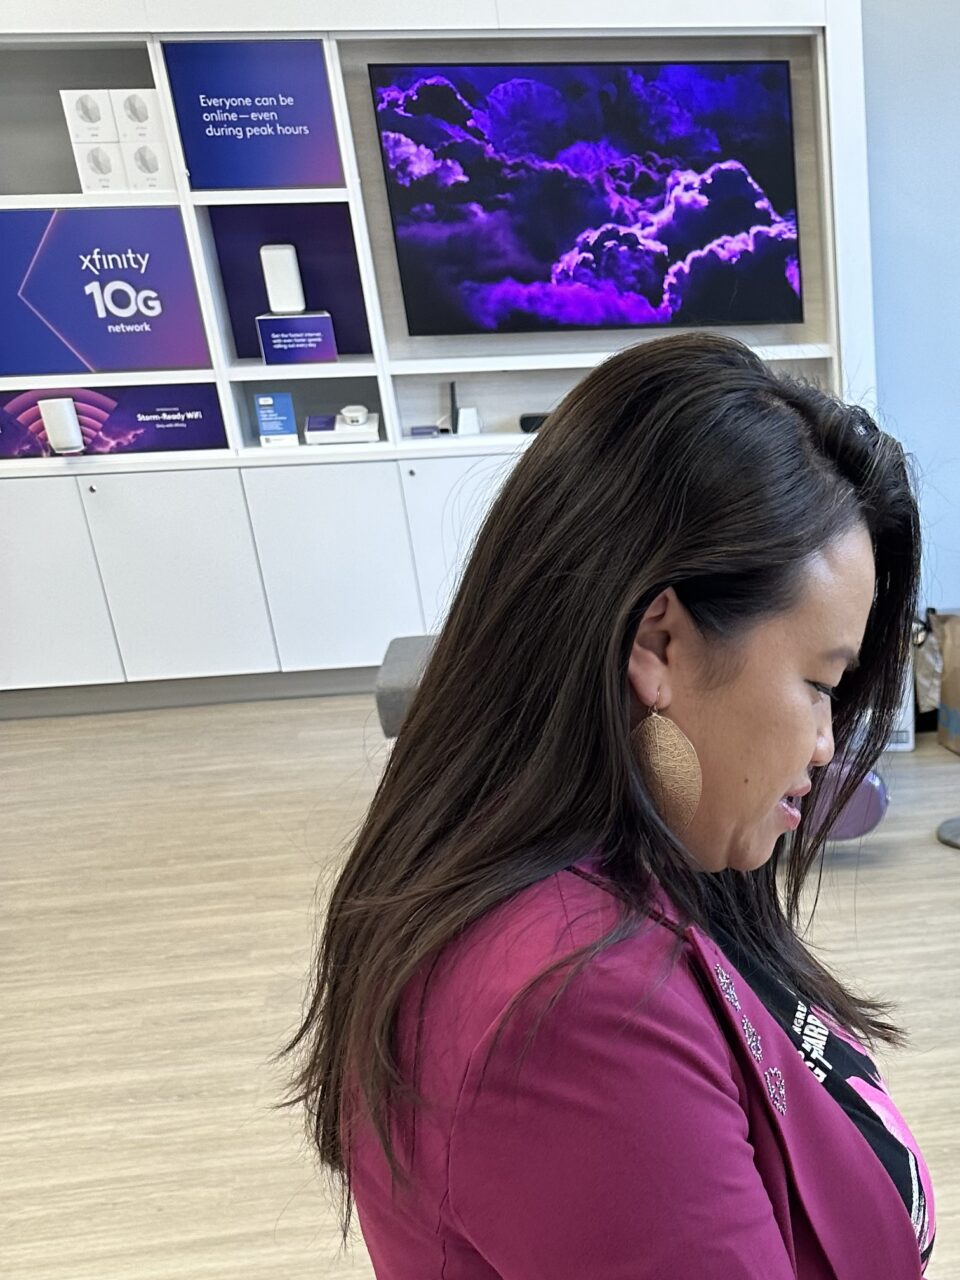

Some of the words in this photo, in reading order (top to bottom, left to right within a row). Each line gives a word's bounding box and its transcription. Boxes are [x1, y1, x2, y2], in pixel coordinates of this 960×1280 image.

[199, 95, 252, 110] Everyone
[254, 96, 277, 106] can
[279, 95, 294, 106] be
[205, 125, 243, 139] during
[245, 124, 274, 137] peak
[276, 123, 309, 135] hours
[79, 248, 149, 274] xfinity
[84, 280, 162, 318] 10G
[107, 321, 151, 333] network
